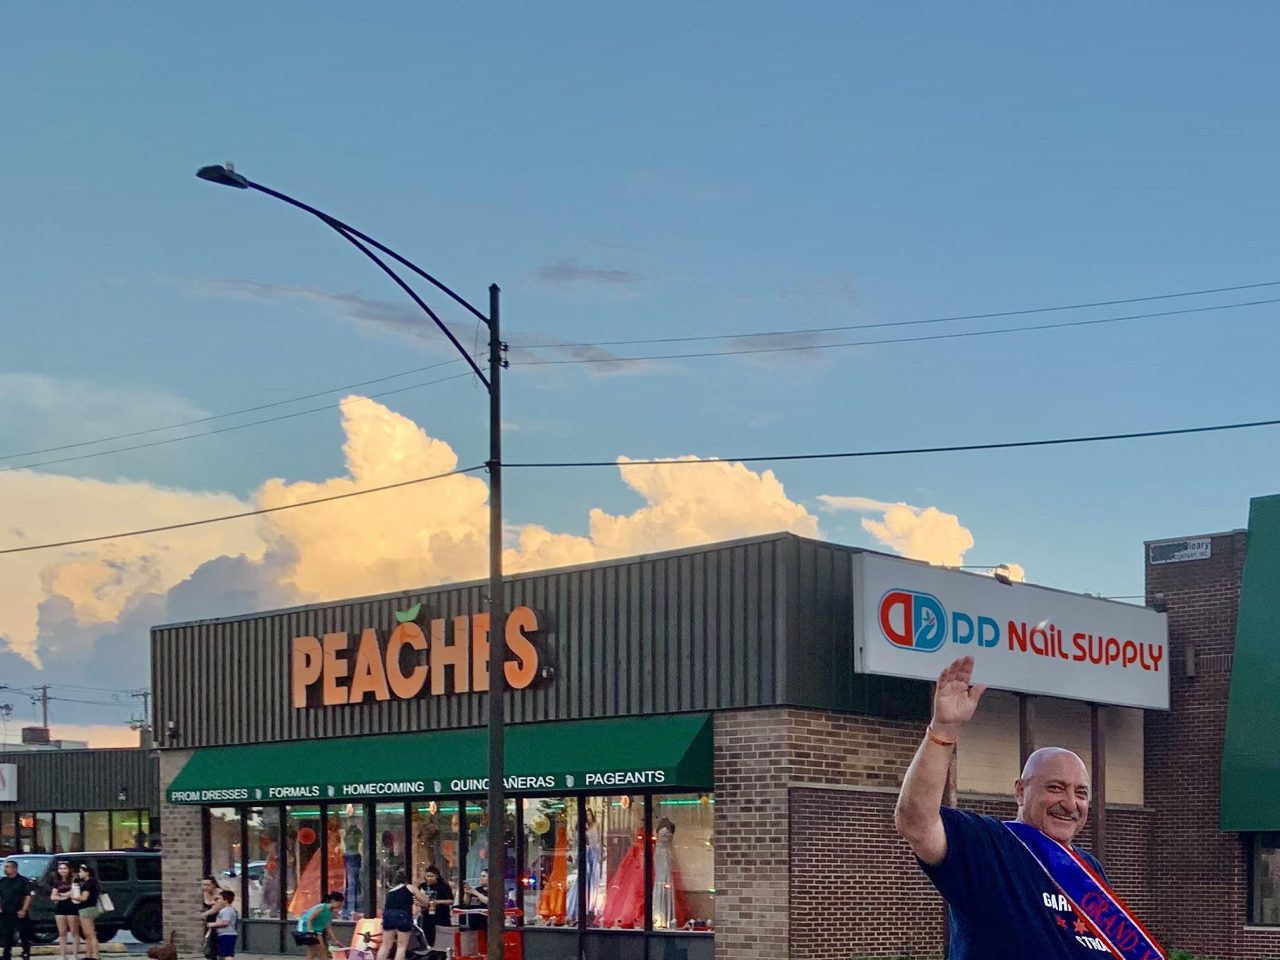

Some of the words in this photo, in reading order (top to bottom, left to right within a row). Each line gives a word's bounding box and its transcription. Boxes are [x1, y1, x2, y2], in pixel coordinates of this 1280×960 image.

[952, 611, 1001, 648] DD
[292, 605, 539, 708] PEACHES
[172, 791, 200, 801] PROM
[201, 789, 248, 801] DRESSES
[268, 785, 320, 798] FORMALS
[342, 781, 425, 795] HOMECOMING
[450, 774, 555, 791] QUINCAÑERAS
[585, 770, 665, 786] PAGEANTS
[1042, 892, 1072, 911] GAR
[1081, 891, 1138, 952] GRAND
[1075, 935, 1112, 953] STRO
